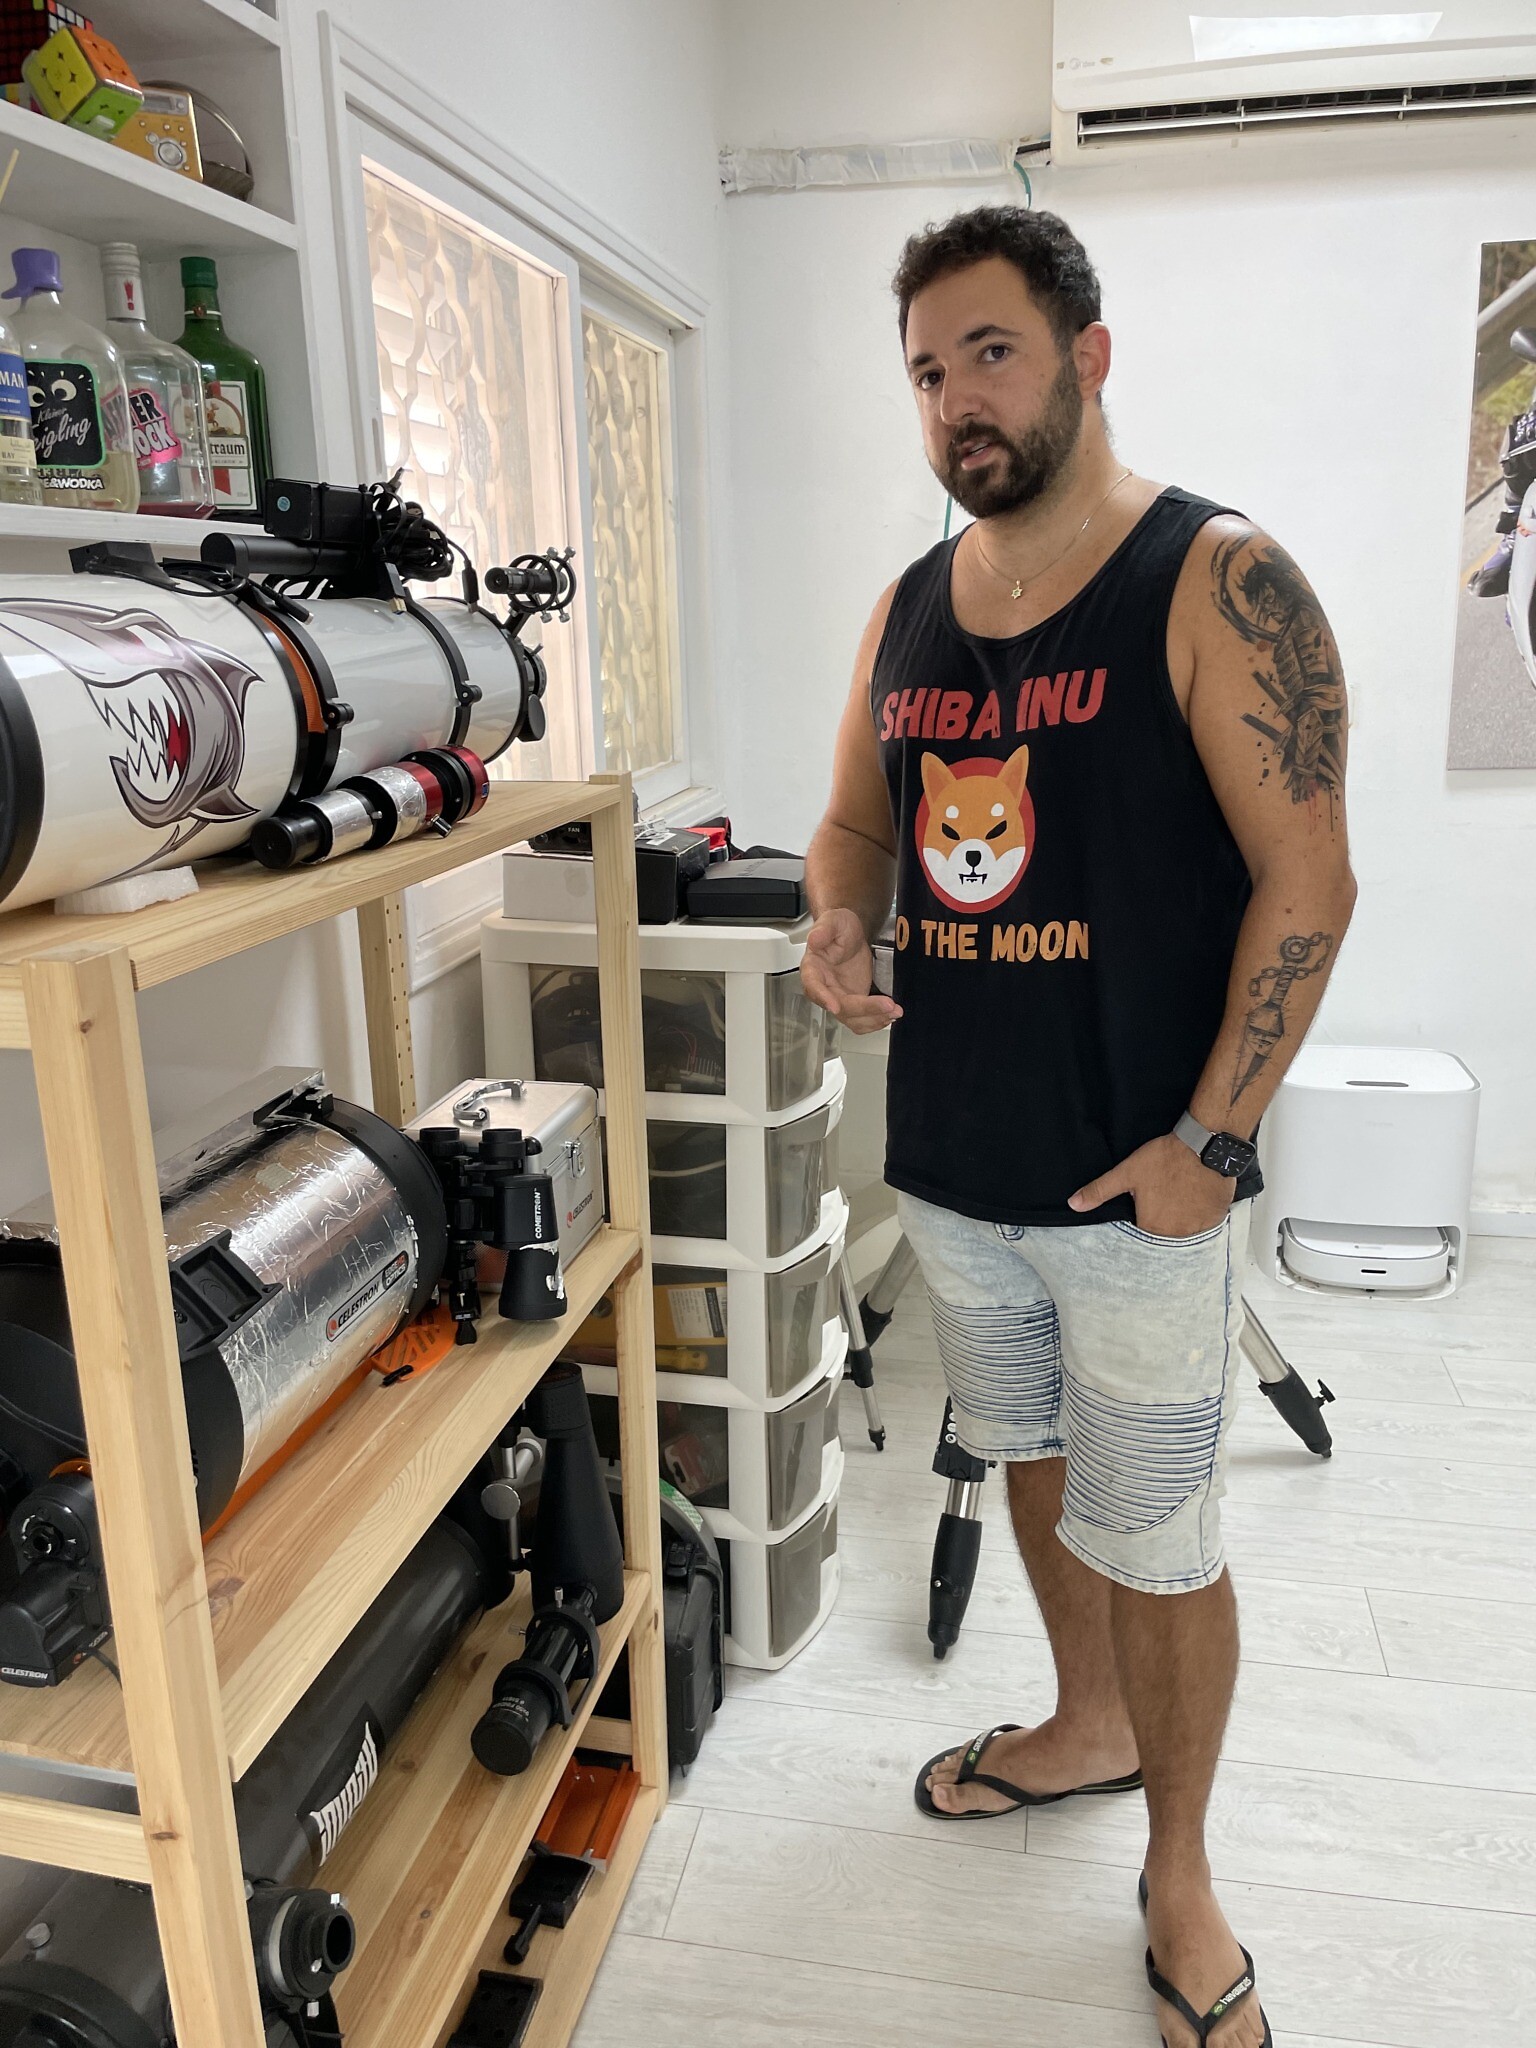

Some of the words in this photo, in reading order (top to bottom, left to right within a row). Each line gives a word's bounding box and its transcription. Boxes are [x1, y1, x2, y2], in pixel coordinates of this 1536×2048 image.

[0, 370, 24, 389] MAN
[33, 413, 91, 458] eigling
[210, 444, 245, 455] traum
[44, 477, 104, 490] E&WODKA
[880, 689, 1000, 741] SHIBA
[1016, 668, 1107, 733] INU
[895, 915, 910, 951] O
[921, 919, 978, 960] THE
[991, 920, 1089, 962] MOON
[534, 1191, 542, 1239] COMETRON
[338, 1280, 380, 1328] CELESTRON
[1, 1667, 49, 1680] CELESTRON
